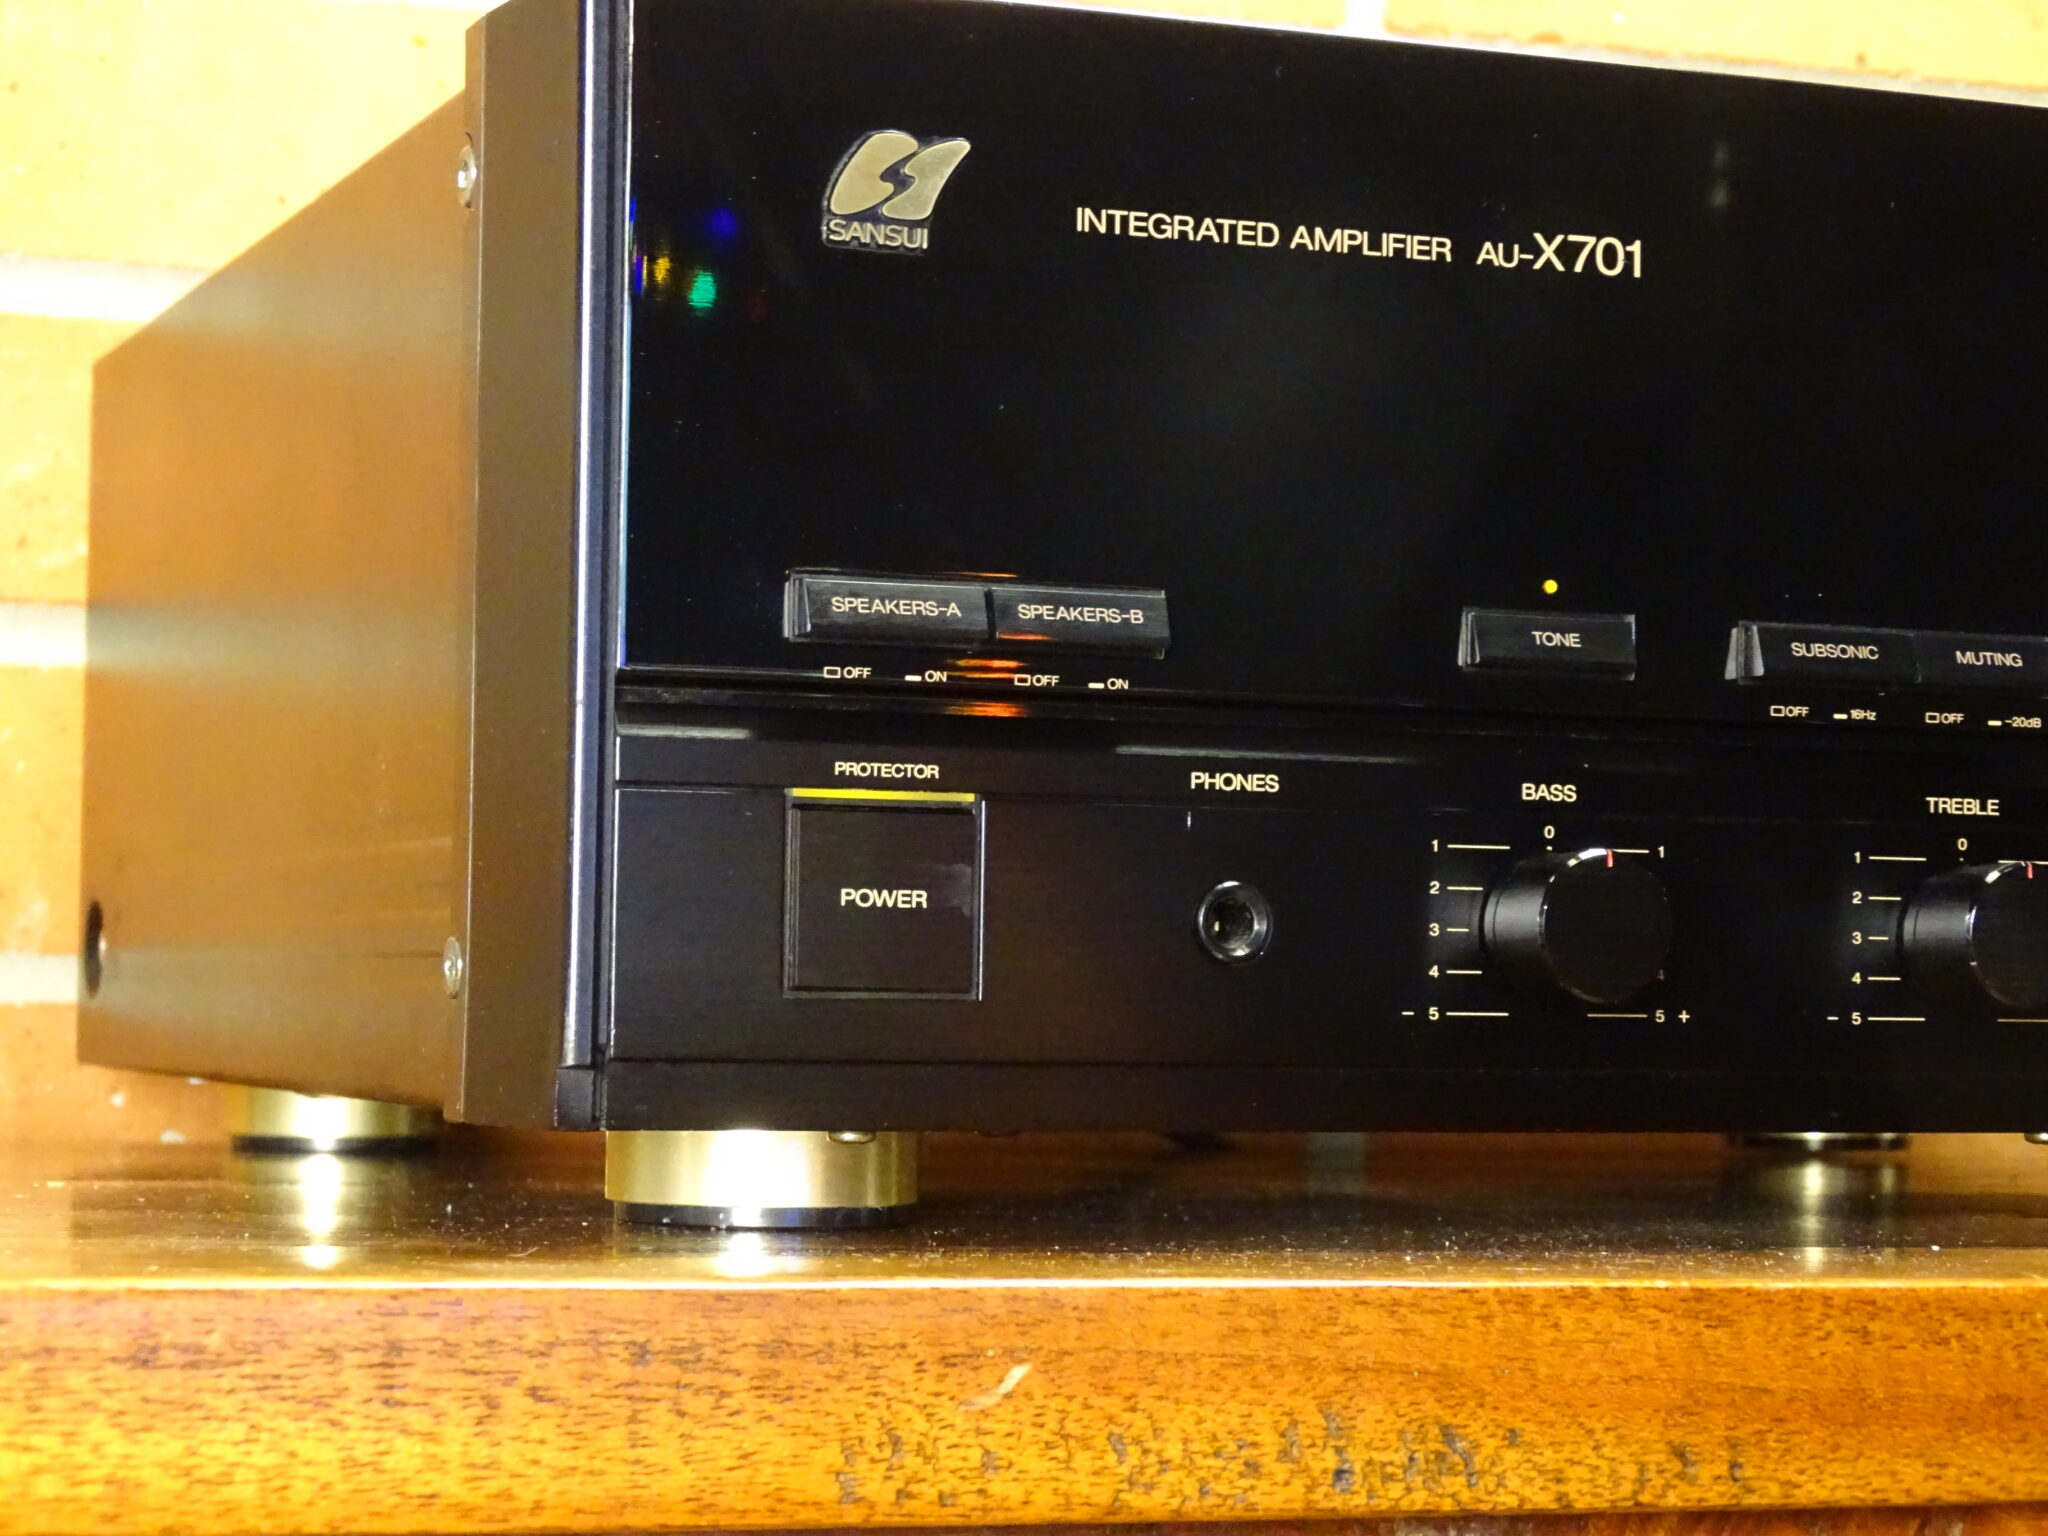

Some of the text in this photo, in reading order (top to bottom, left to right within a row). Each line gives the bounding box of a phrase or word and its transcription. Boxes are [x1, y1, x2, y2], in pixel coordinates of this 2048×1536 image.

[828, 218, 929, 250] SANSUI
[1076, 206, 1642, 279] INTEGRATED AMPLIFIER AU-X701
[831, 596, 962, 618] SPEAKERS-A
[1017, 603, 1144, 624] SPEAKERS-B
[1531, 631, 1582, 648] TONE
[1790, 641, 1880, 660] SUBSONIC
[1955, 650, 2024, 668] MUTING
[842, 666, 872, 679] OFF
[924, 670, 948, 683] ON
[1031, 674, 1060, 687] OFF
[1106, 677, 1129, 690] ON
[1784, 705, 1810, 718] OFF
[1849, 708, 1877, 721] 16Hz
[1940, 712, 1965, 725] OFF
[834, 761, 940, 780] PROTECTOR
[1190, 771, 1280, 793] PHONES
[1521, 782, 1578, 803] BASS
[1925, 796, 2000, 816] TREBLE
[1543, 825, 1555, 839] 0
[1431, 839, 1439, 853] 1
[1957, 837, 1968, 851] 0
[1657, 845, 1665, 859] 1
[1853, 851, 1861, 864] 1
[1429, 880, 1441, 895] 2
[840, 887, 928, 909] POWER
[1851, 890, 1863, 905] 2
[1428, 922, 1440, 937] 3
[1851, 931, 1863, 945] 3
[1428, 964, 1440, 979] 4
[1851, 971, 1862, 985] 4
[1428, 1006, 1440, 1021] 5
[1655, 1009, 1666, 1023] 5
[1851, 1011, 1862, 1026] 5
